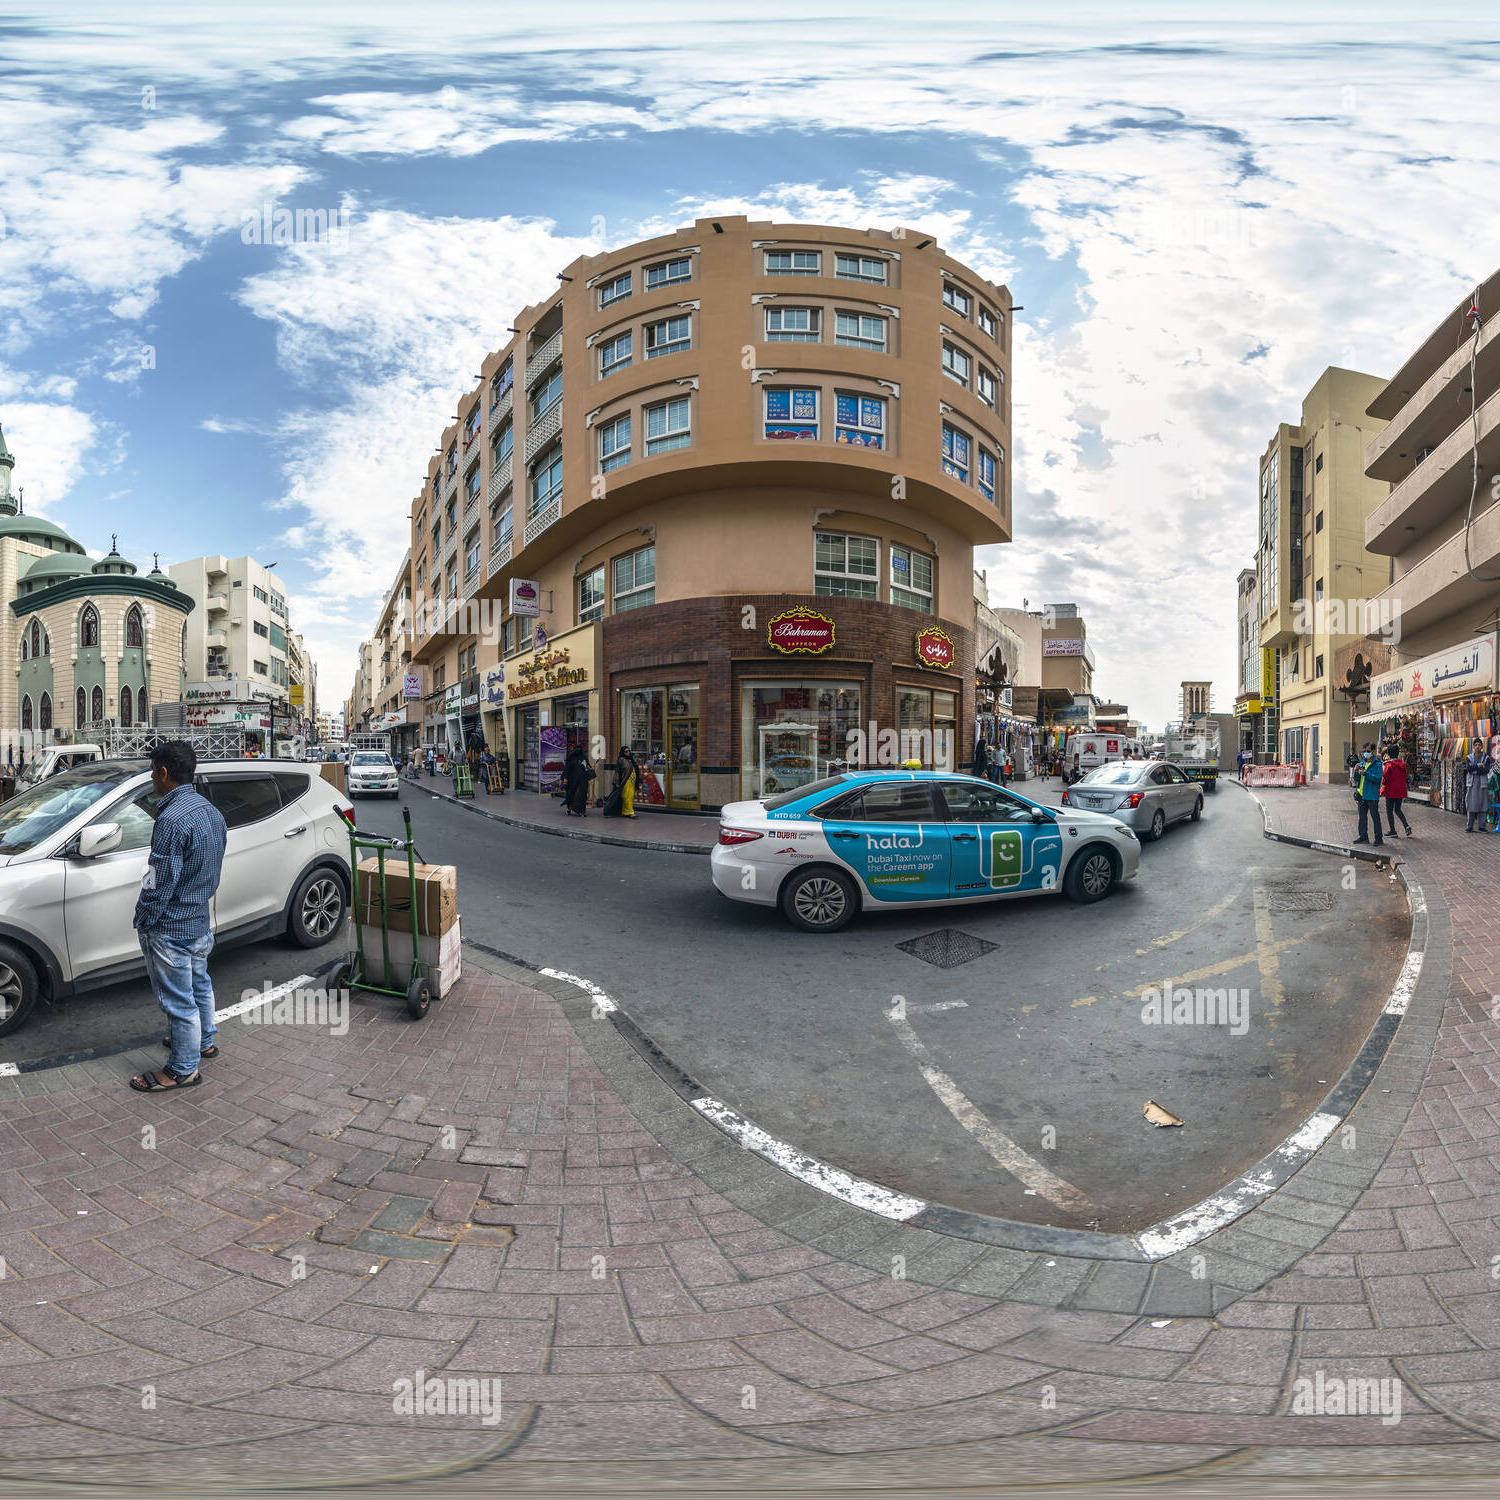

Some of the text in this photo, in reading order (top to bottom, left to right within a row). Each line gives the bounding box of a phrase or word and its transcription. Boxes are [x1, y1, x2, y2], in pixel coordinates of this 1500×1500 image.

[774, 623, 829, 637] Bahraman
[1431, 650, 1479, 689] الشفق
[545, 666, 588, 690] Saffron
[1377, 686, 1383, 700] AL
[868, 855, 893, 863] Dubai
[894, 854, 911, 862] Taxi
[883, 863, 916, 871] Careem
[918, 862, 934, 871] app
